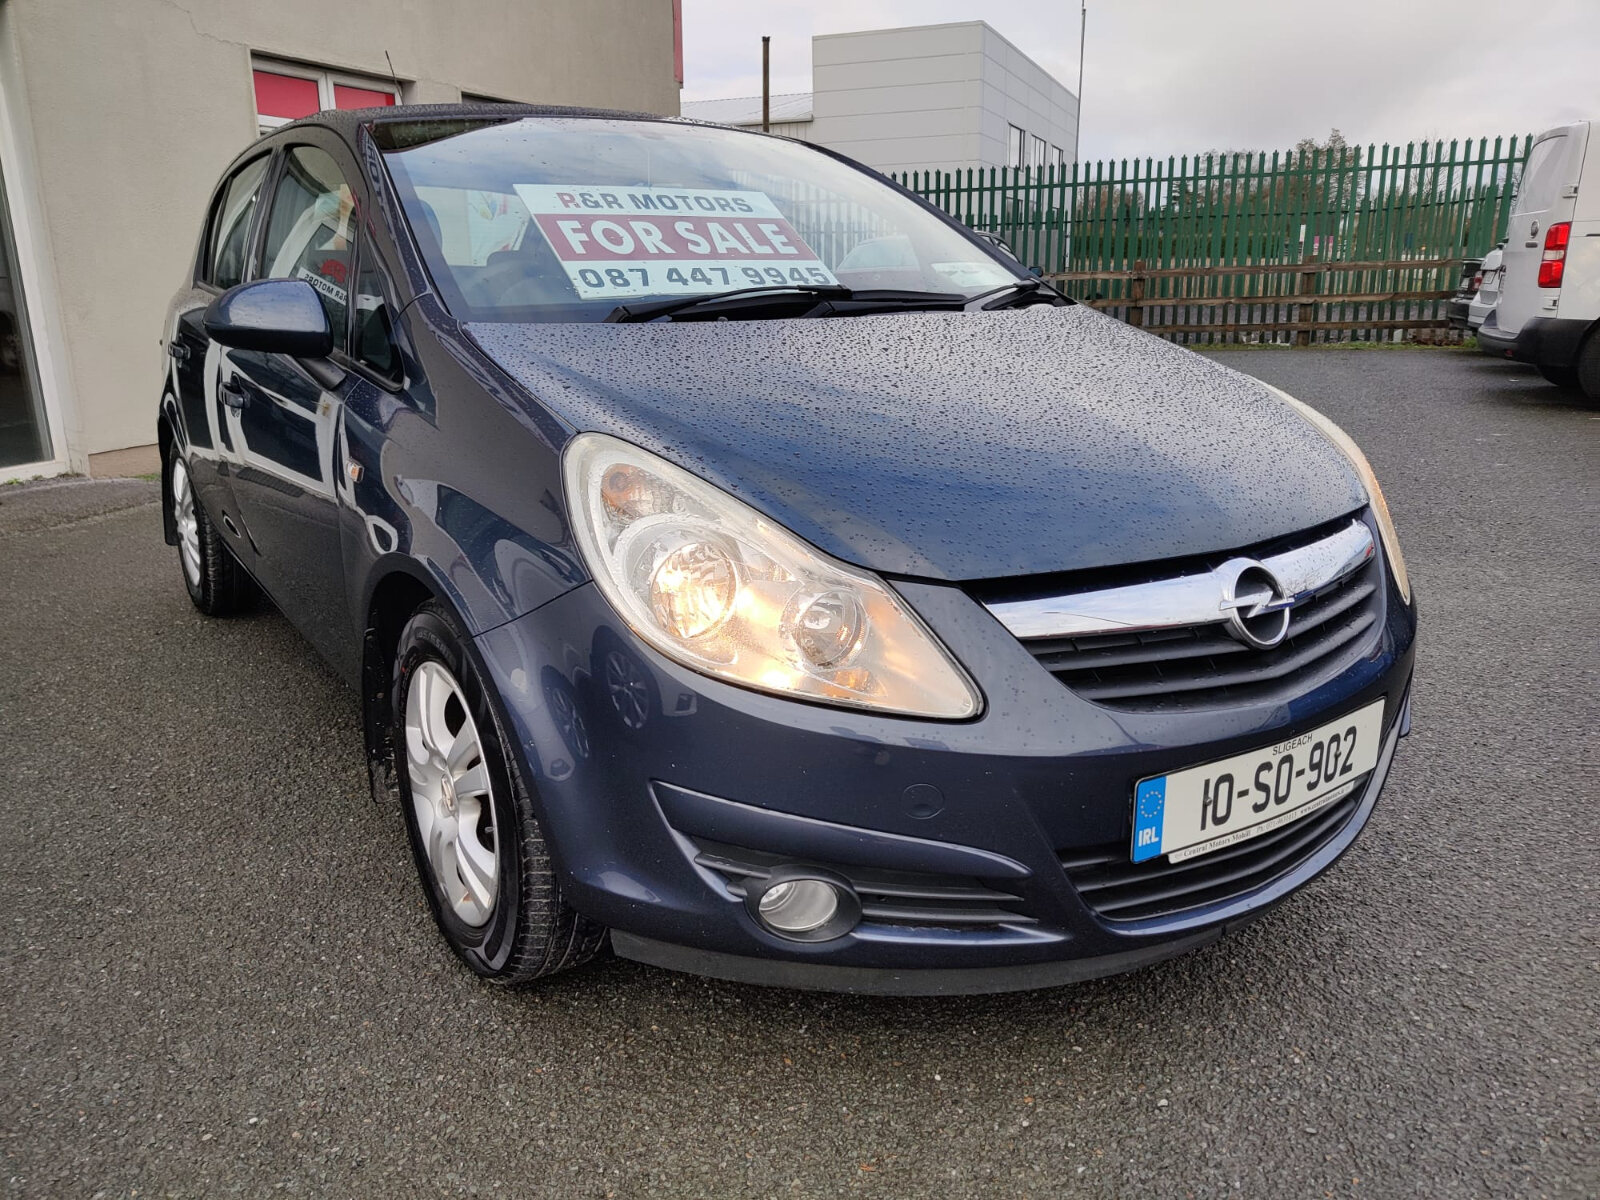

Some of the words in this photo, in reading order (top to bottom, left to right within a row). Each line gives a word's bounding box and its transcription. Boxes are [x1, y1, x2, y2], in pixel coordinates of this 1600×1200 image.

[556, 192, 623, 209] R&R
[627, 193, 754, 213] MOTORS
[556, 220, 677, 255] FOR
[674, 221, 799, 255] SALE
[578, 268, 650, 288] 087
[666, 267, 729, 287] 447
[741, 266, 831, 286] 9945
[1272, 733, 1313, 756] SLIGEACH
[1200, 725, 1357, 831] 10-SO-902
[1138, 826, 1160, 848] IRL
